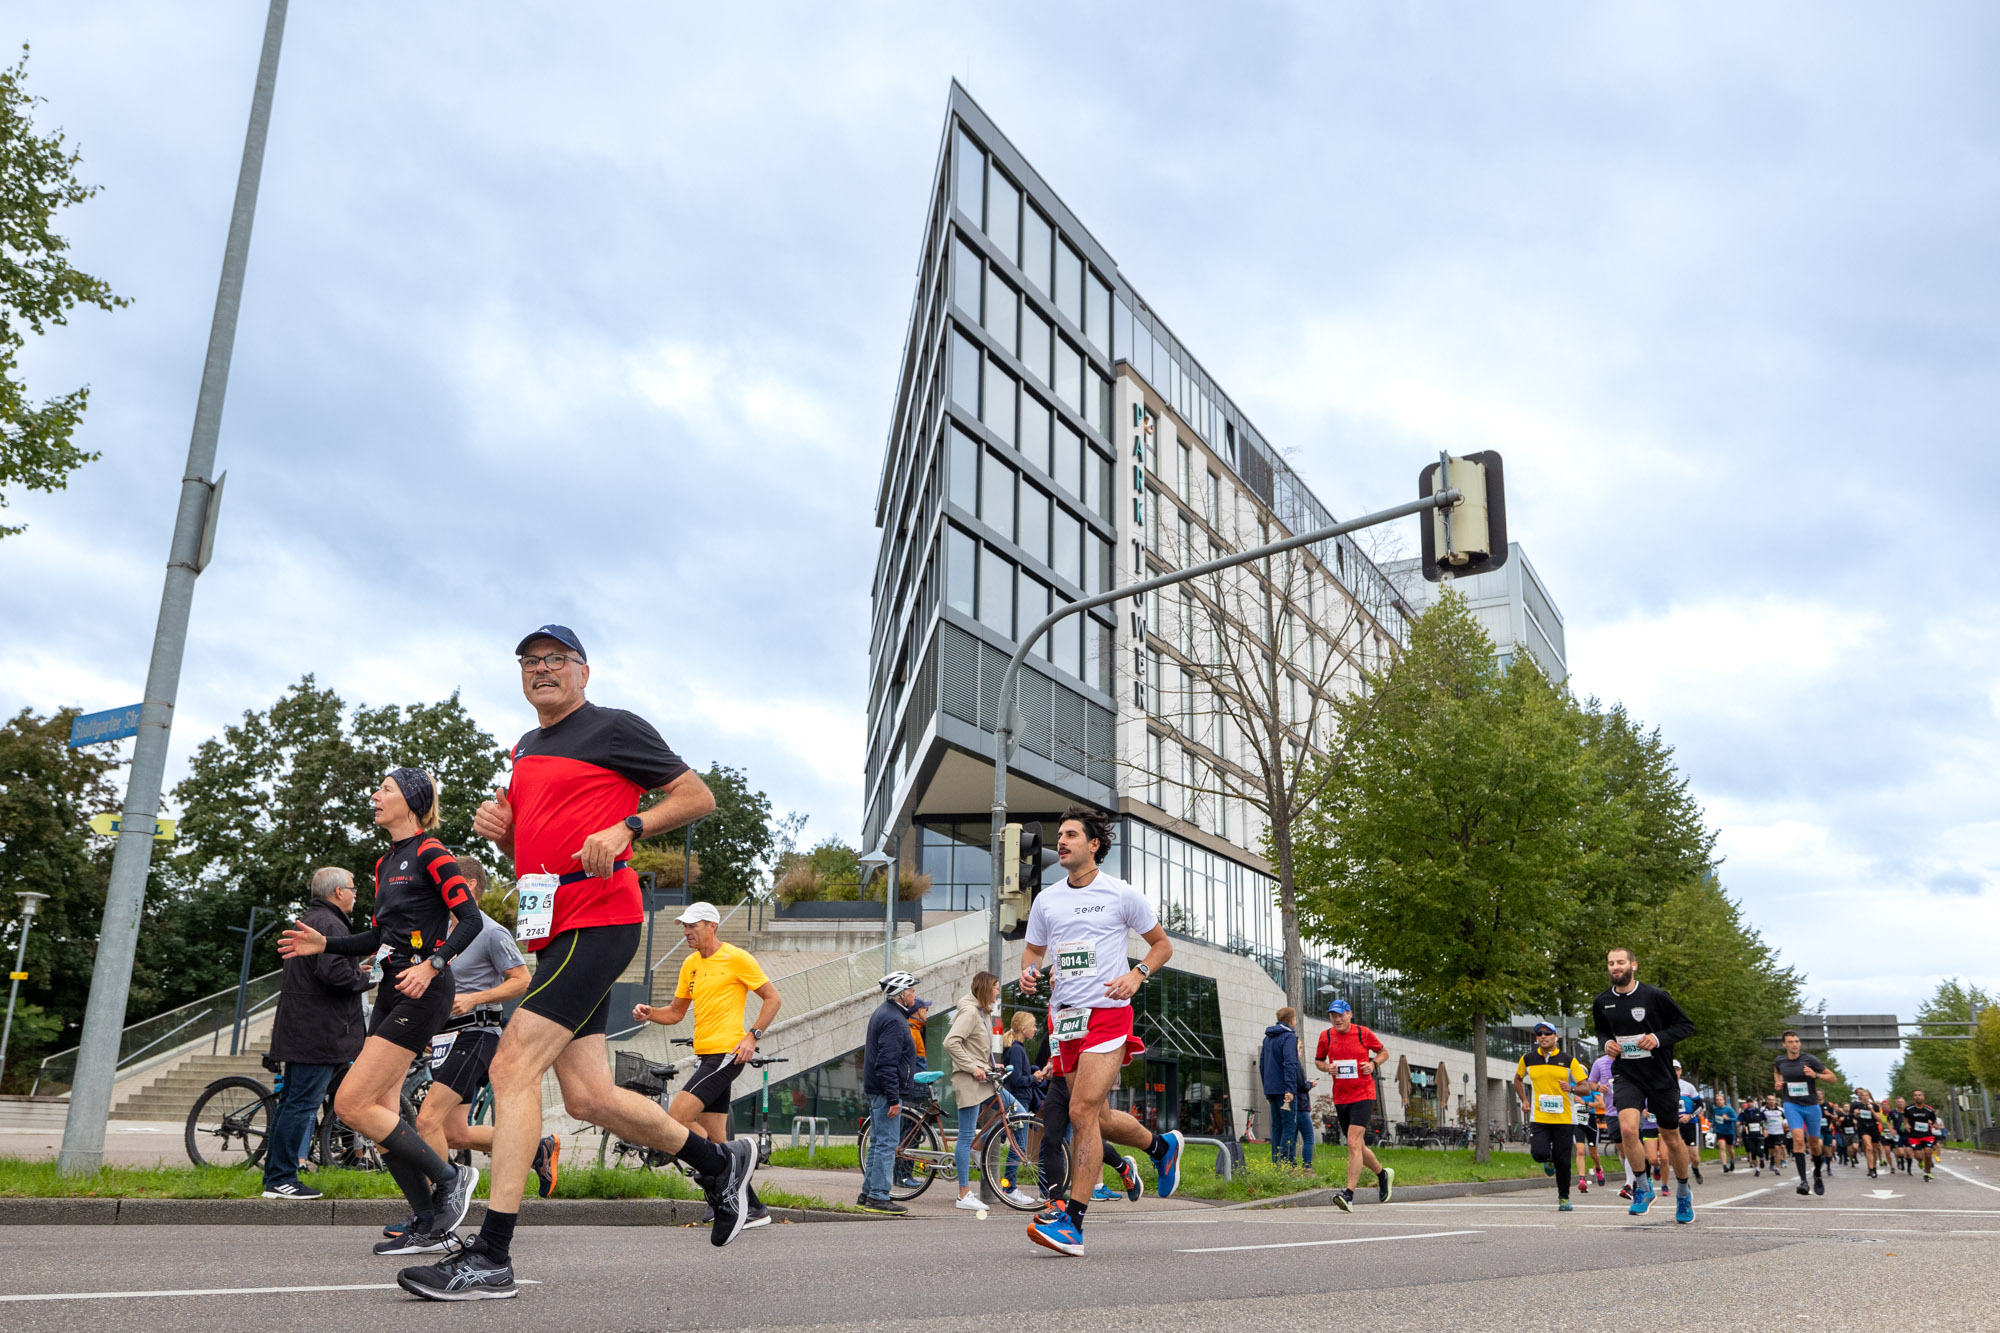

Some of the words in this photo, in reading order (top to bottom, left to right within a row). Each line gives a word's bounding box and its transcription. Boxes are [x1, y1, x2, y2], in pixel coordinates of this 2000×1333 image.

[1133, 403, 1144, 527] PARK
[74, 715, 122, 740] Stuttgarter
[525, 927, 546, 937] 2743
[1061, 955, 1088, 967] 8014-1
[1062, 1019, 1080, 1032] 8014
[433, 1046, 447, 1058] 401
